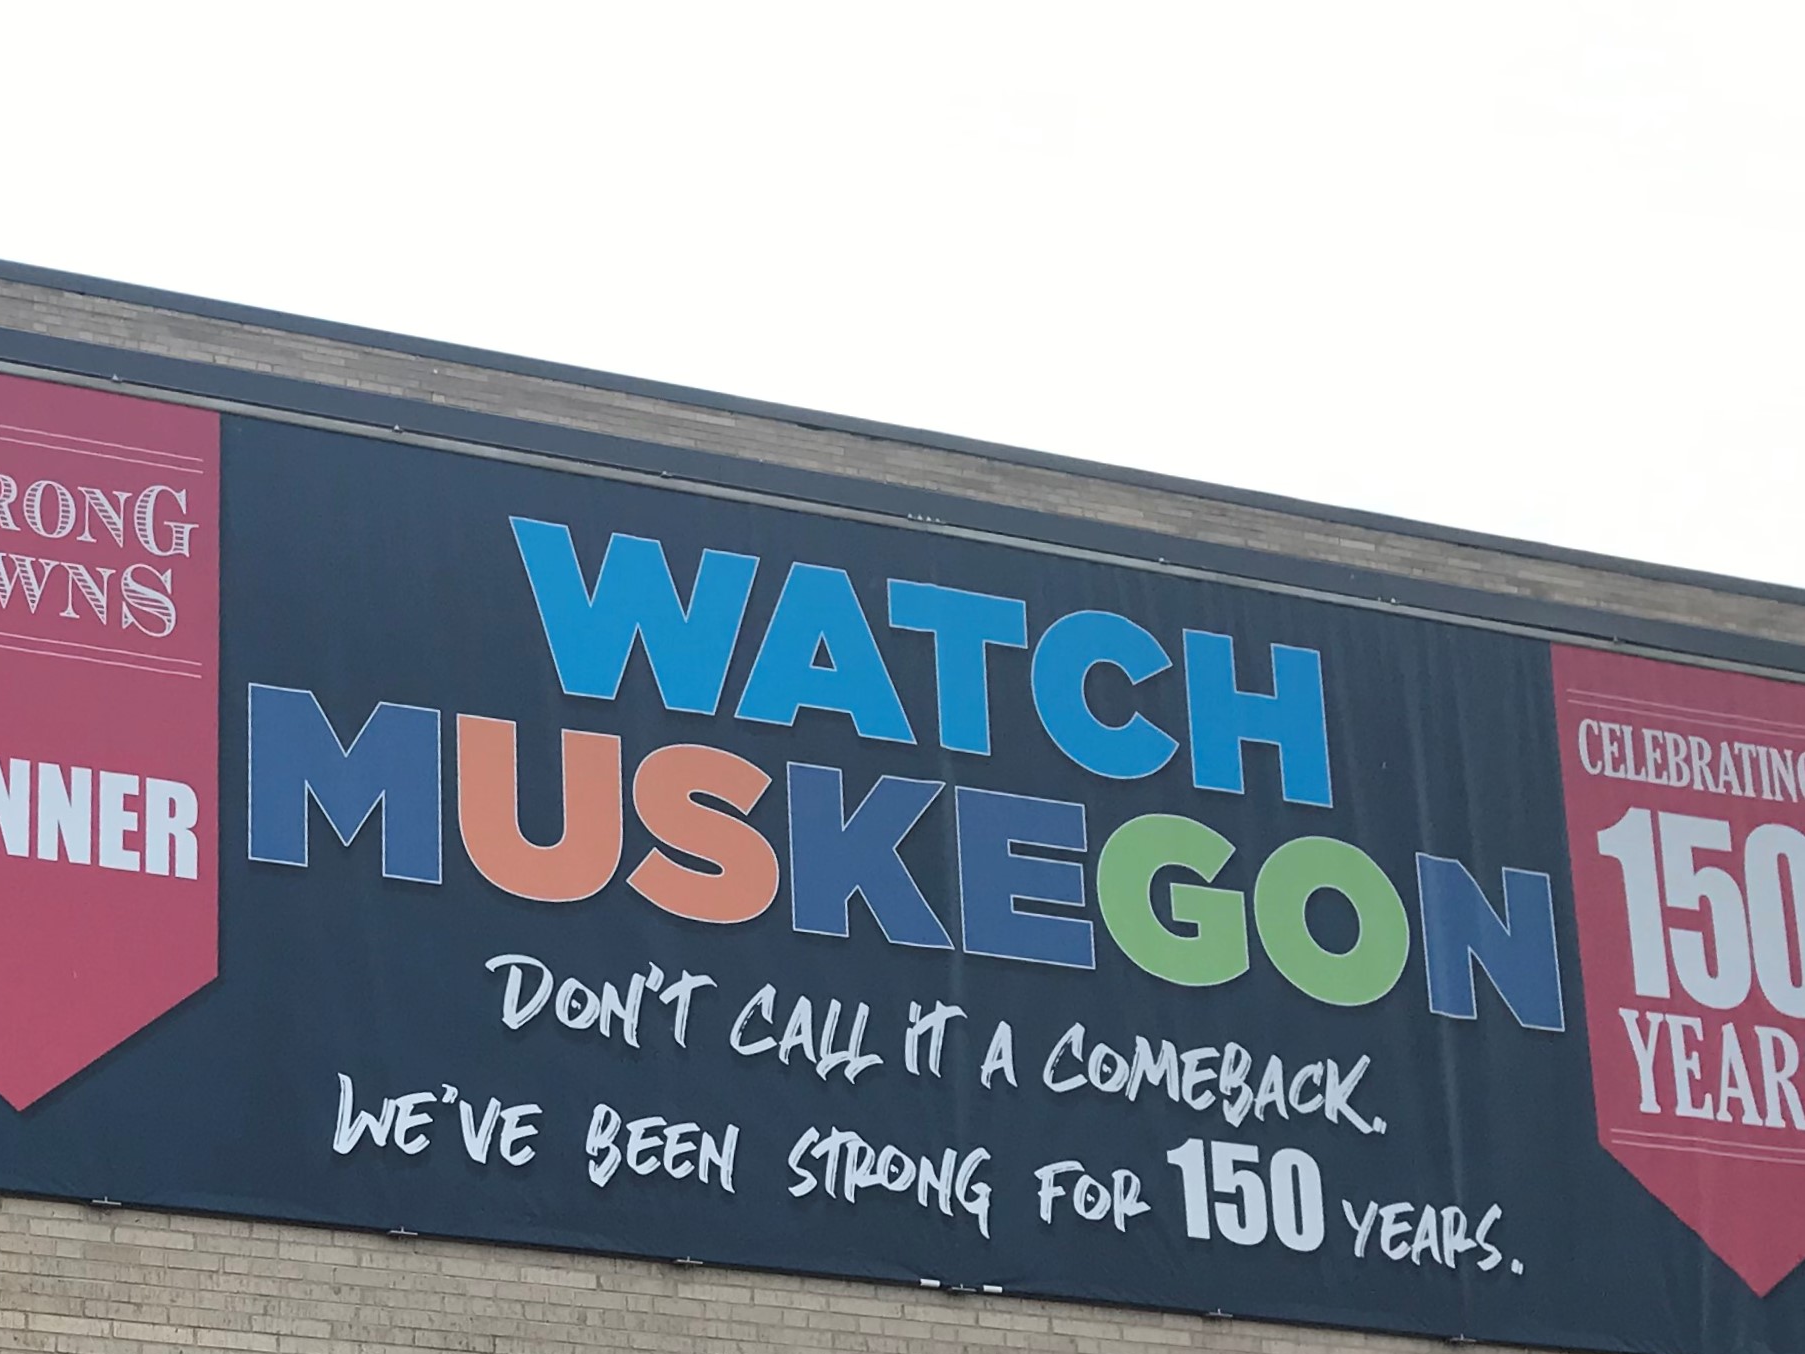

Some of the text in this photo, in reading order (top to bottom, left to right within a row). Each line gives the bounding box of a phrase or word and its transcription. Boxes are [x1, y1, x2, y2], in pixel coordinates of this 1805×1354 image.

[509, 516, 1333, 808] WATCH
[249, 682, 1565, 1032] MUSKEGON
[1596, 806, 1805, 1020] 150
[485, 953, 717, 1049] DON'T
[729, 983, 884, 1085] CALL
[980, 1021, 1018, 1090] A
[1042, 1022, 1387, 1136] COMEBACK.
[332, 1072, 1524, 1275] WE'VE BEEN STRONG FOR 150 YEARS.
